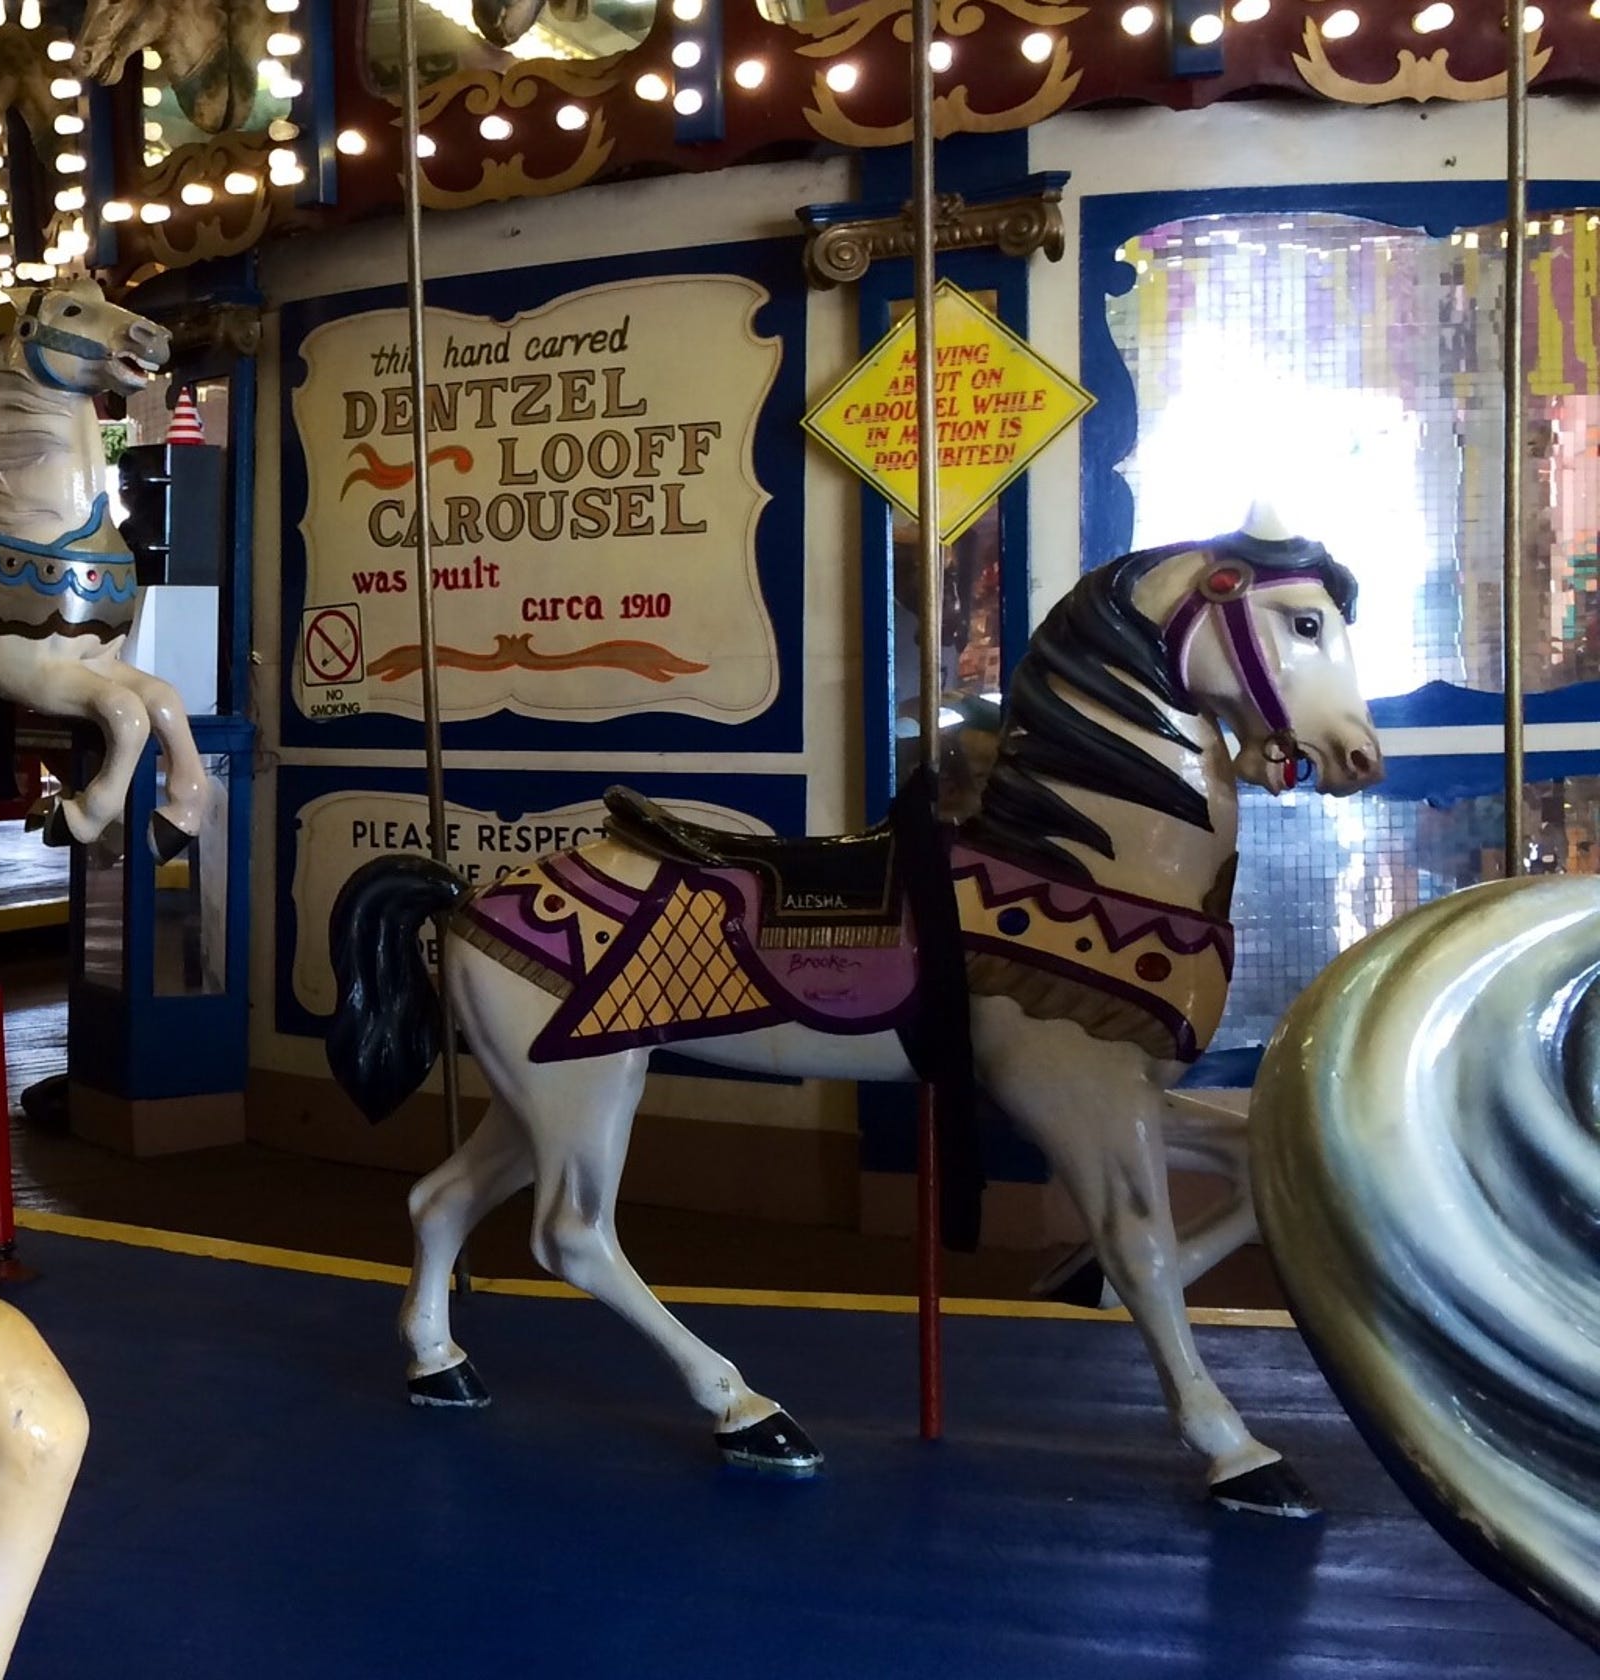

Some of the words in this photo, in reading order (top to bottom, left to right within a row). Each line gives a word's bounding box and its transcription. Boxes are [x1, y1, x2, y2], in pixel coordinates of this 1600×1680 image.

[370, 343, 413, 377] thi
[443, 331, 511, 369] hand
[524, 315, 630, 361] carved
[898, 343, 990, 371] MVING
[884, 371, 962, 397] ABUT
[970, 367, 1005, 390] ON
[342, 367, 647, 440] DENTZEL
[843, 396, 960, 425] CAROUEL
[972, 388, 1047, 415] WHILE
[865, 426, 890, 448] IN
[897, 419, 990, 446] MTION
[998, 416, 1023, 438] IS
[498, 421, 721, 486] LOOFF
[871, 442, 1017, 472] PROBITED!
[368, 483, 707, 548] CAROUSEL
[352, 569, 408, 595] was
[521, 595, 604, 622] circa
[619, 592, 671, 619] 1910
[310, 702, 361, 717] SMOKING
[326, 689, 344, 701] NO
